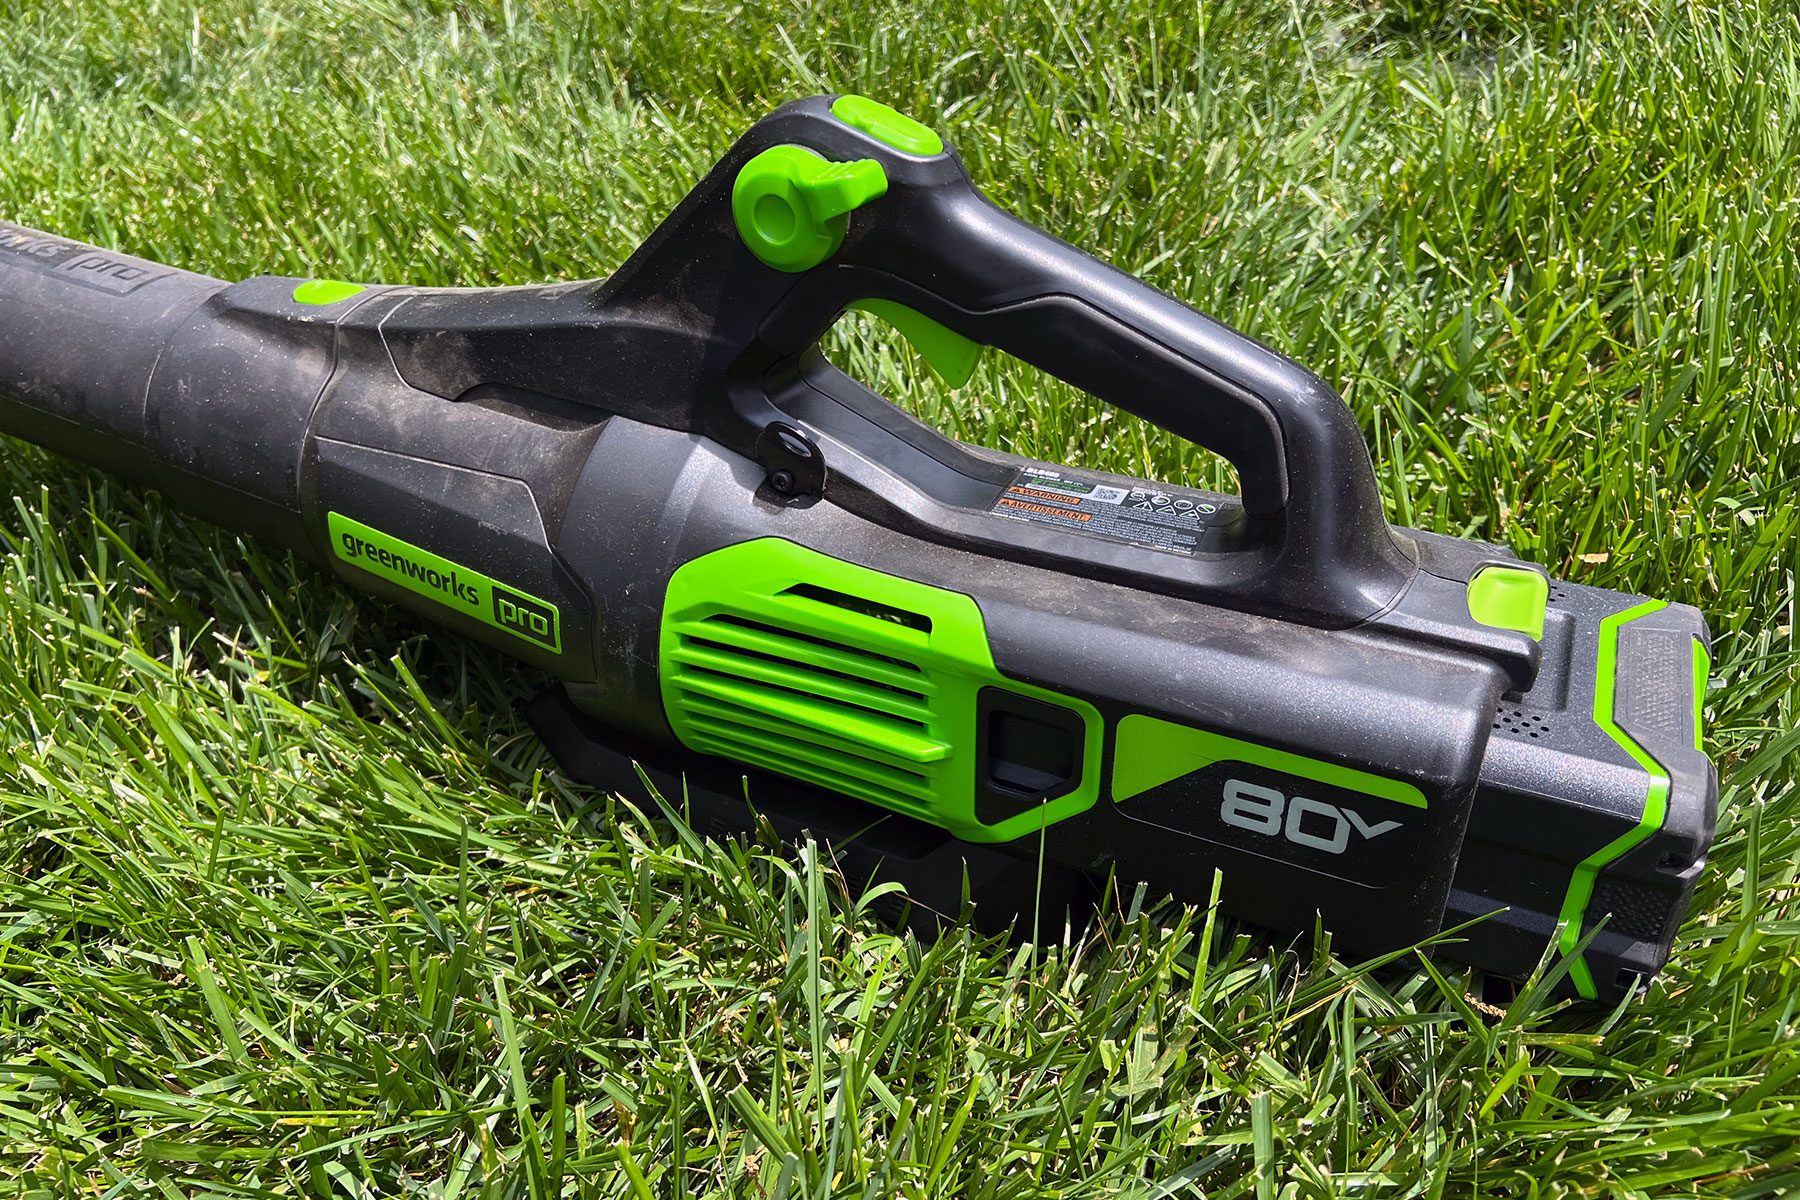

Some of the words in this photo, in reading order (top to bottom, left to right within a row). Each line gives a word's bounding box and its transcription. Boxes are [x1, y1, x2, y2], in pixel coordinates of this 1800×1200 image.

[66, 256, 150, 281] pro
[1022, 488, 1074, 503] WARNING
[1011, 500, 1086, 519] AVERTISSEMENT
[342, 533, 480, 606] greenworks
[499, 598, 548, 637] pro
[1220, 778, 1404, 855] 80V
